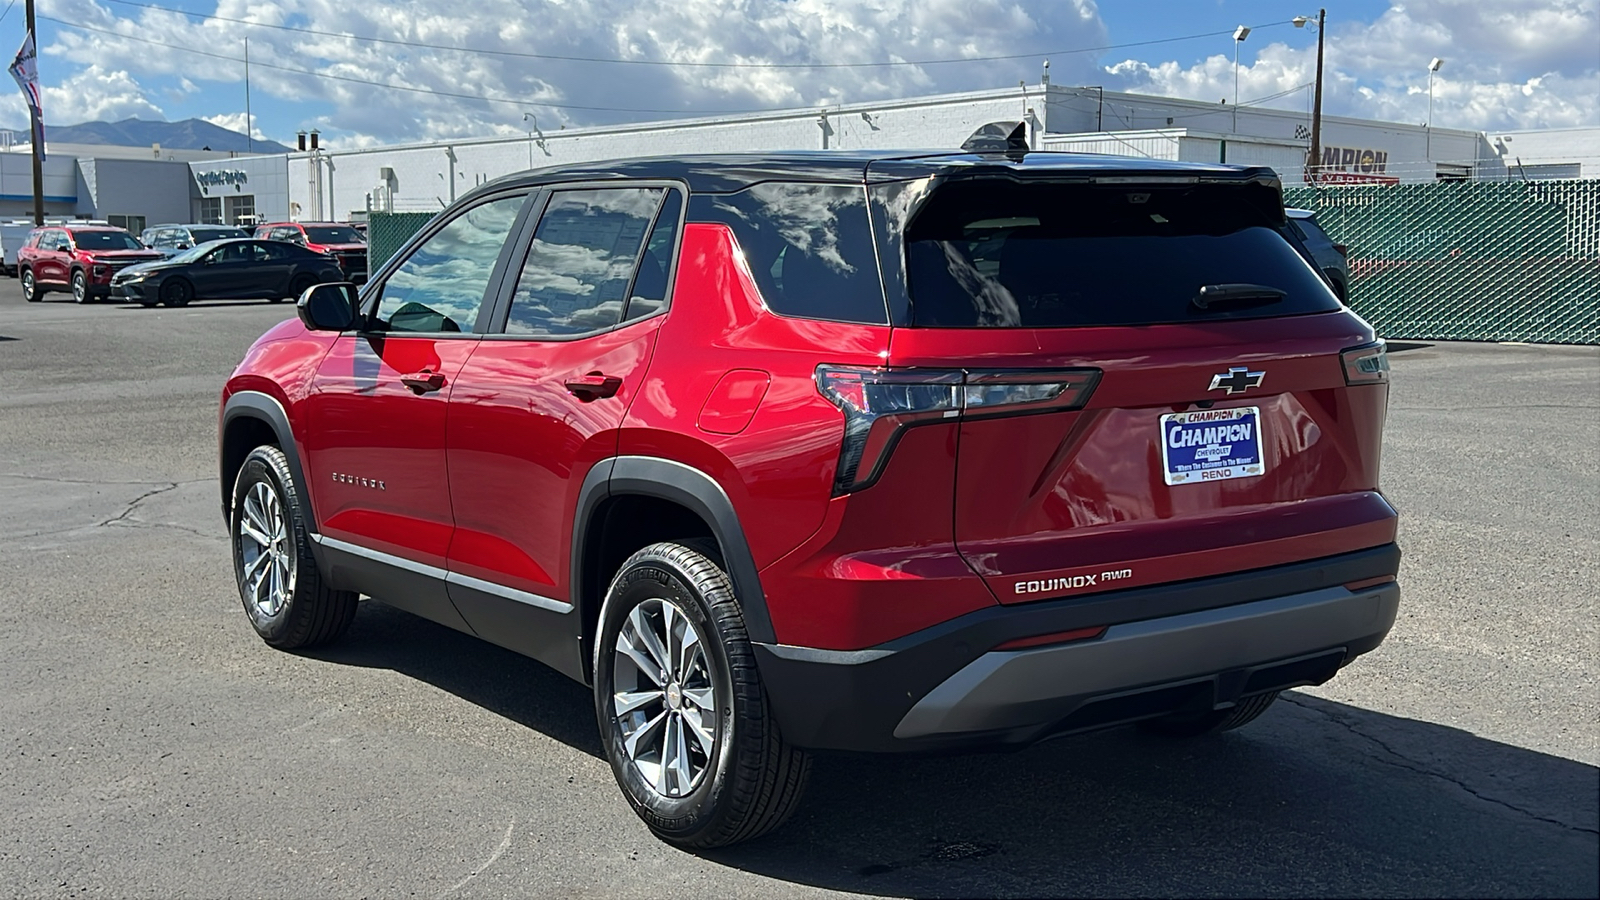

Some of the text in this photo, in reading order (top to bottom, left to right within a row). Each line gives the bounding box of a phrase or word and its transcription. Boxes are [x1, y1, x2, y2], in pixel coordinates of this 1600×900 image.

[1321, 147, 1388, 174] MPION
[1188, 410, 1234, 423] CHAMPION
[1169, 423, 1251, 449] CHAMPION
[1197, 447, 1230, 457] CHEVROLET
[1192, 462, 1201, 470] The
[1202, 460, 1222, 469] Customer
[1228, 458, 1236, 466] The
[332, 472, 386, 491] EQUINOX
[1202, 469, 1231, 480] RENO
[628, 569, 669, 586] MICHELIN
[1014, 569, 1132, 594] EQUINOX AWD
